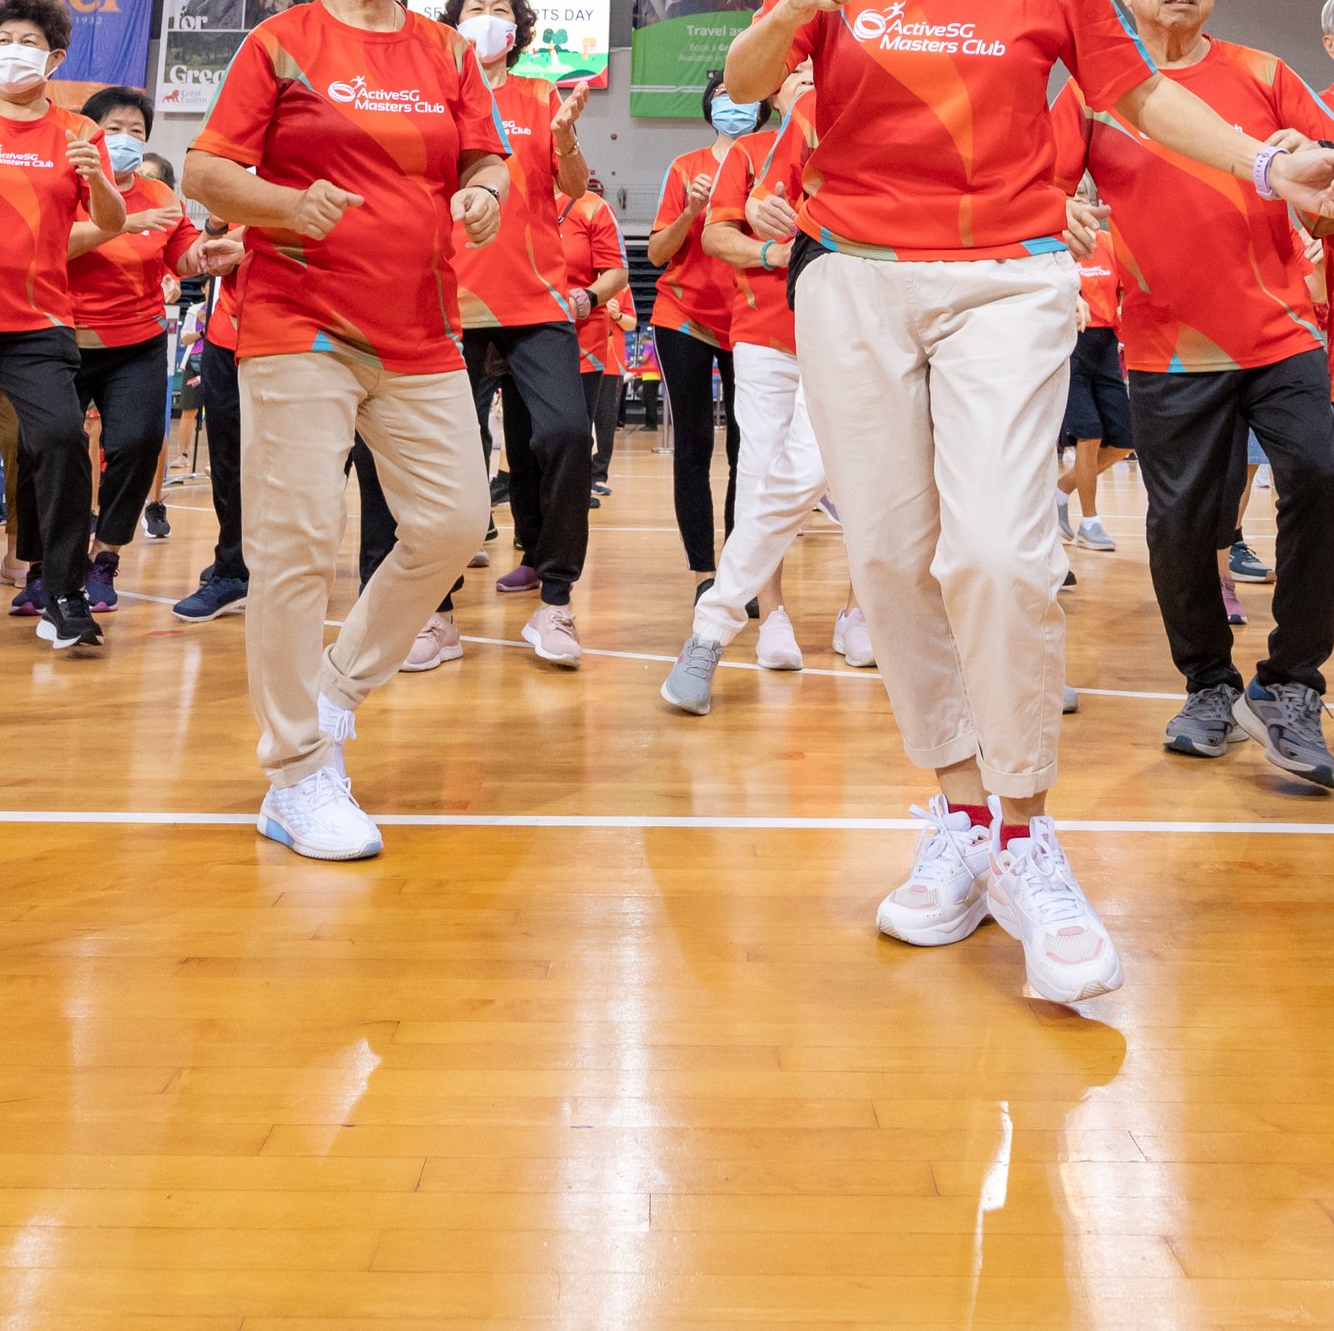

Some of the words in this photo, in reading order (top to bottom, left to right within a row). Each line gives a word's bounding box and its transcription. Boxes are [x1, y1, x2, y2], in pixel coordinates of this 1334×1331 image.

[564, 8, 594, 21] DAY
[687, 25, 726, 37] Travel
[886, 19, 976, 38] ActiveSG
[879, 34, 958, 54] Masters
[962, 39, 1006, 56] Club
[356, 87, 420, 102] ActiveSG
[354, 98, 412, 113] Masters
[414, 101, 445, 114] Club
[32, 159, 54, 168] Club
